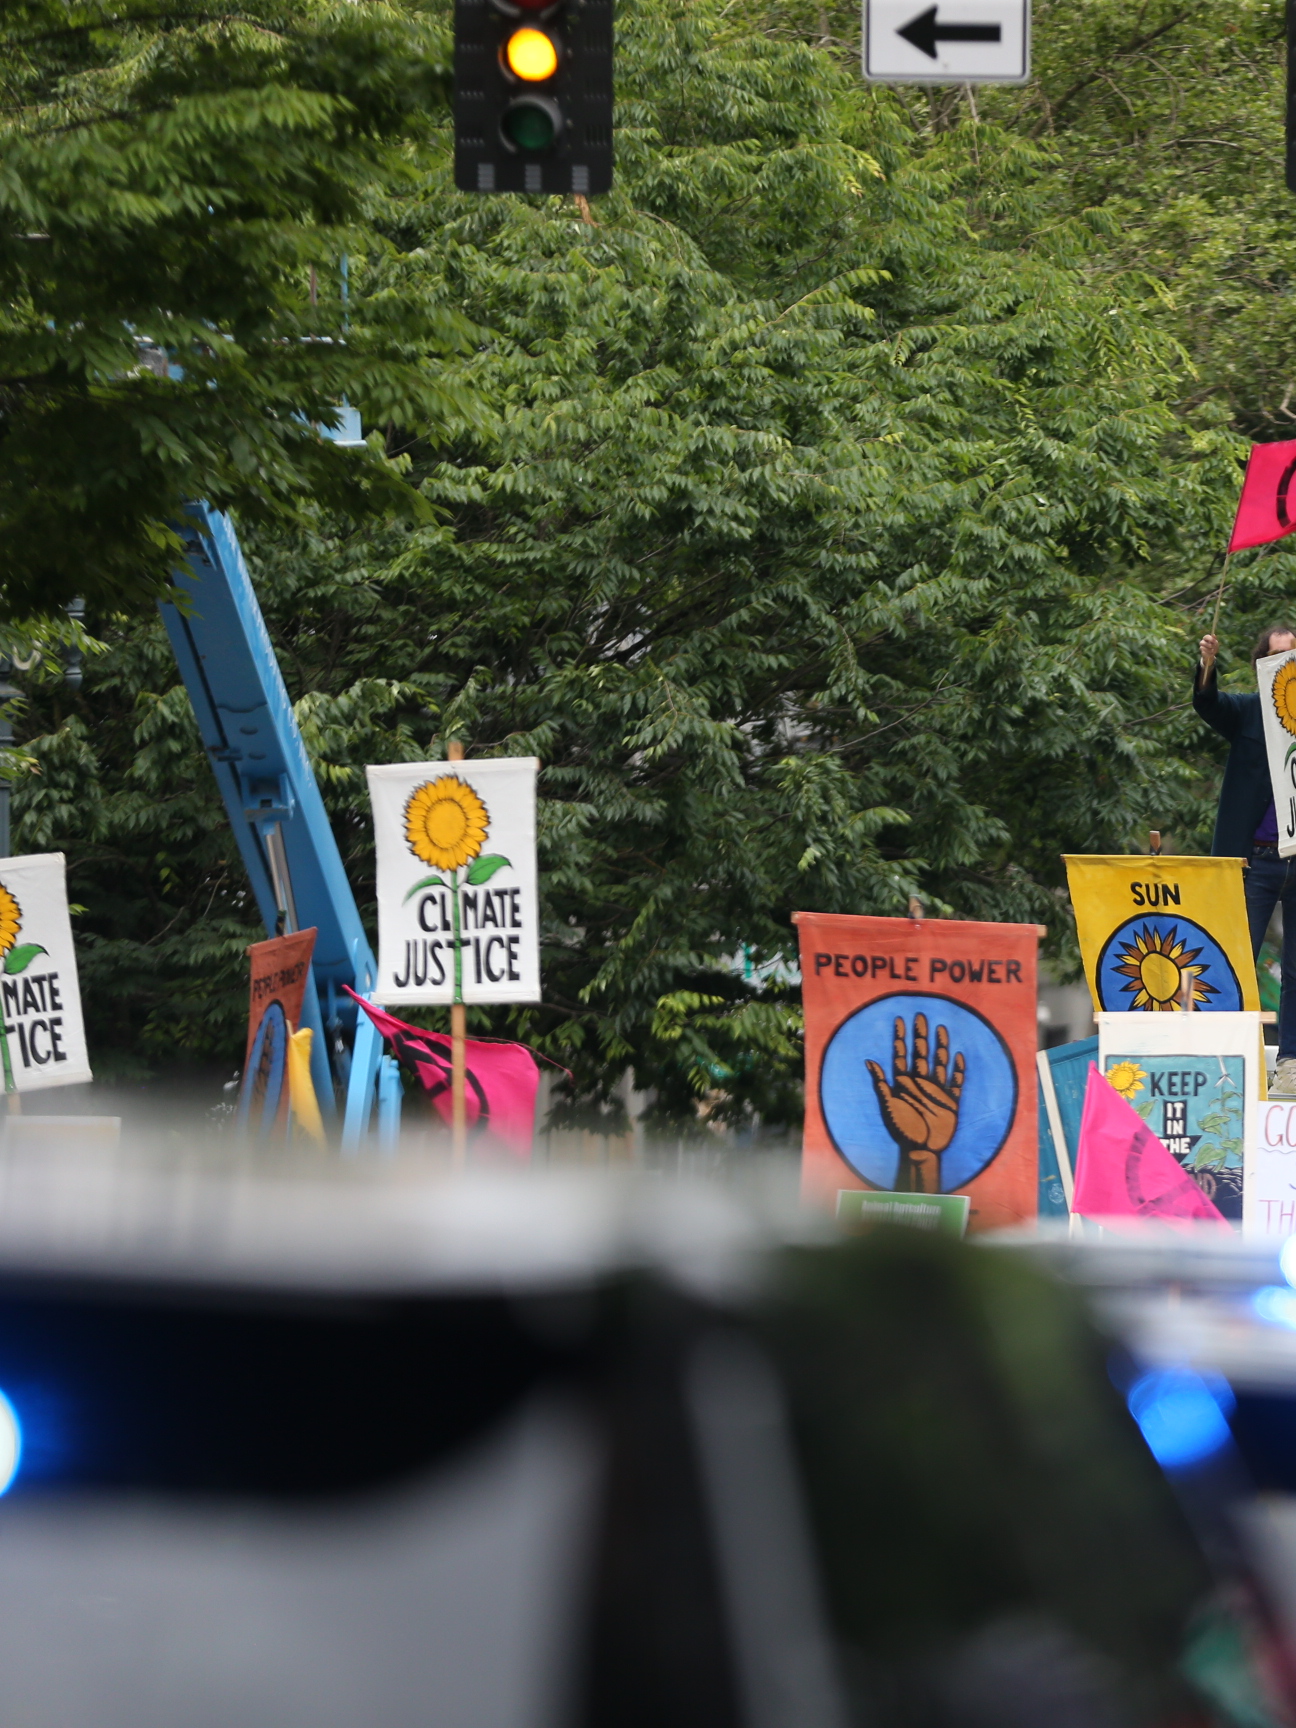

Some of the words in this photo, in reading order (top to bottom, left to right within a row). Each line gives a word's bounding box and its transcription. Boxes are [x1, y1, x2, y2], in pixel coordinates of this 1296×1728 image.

[1130, 882, 1181, 906] SUN
[393, 934, 521, 988] JUSTICE
[814, 952, 919, 981] PEOPLE
[929, 957, 1023, 984] POWER
[1150, 1070, 1208, 1097] KEEP
[1166, 1101, 1185, 1118] IT
[1166, 1119, 1184, 1135] IN
